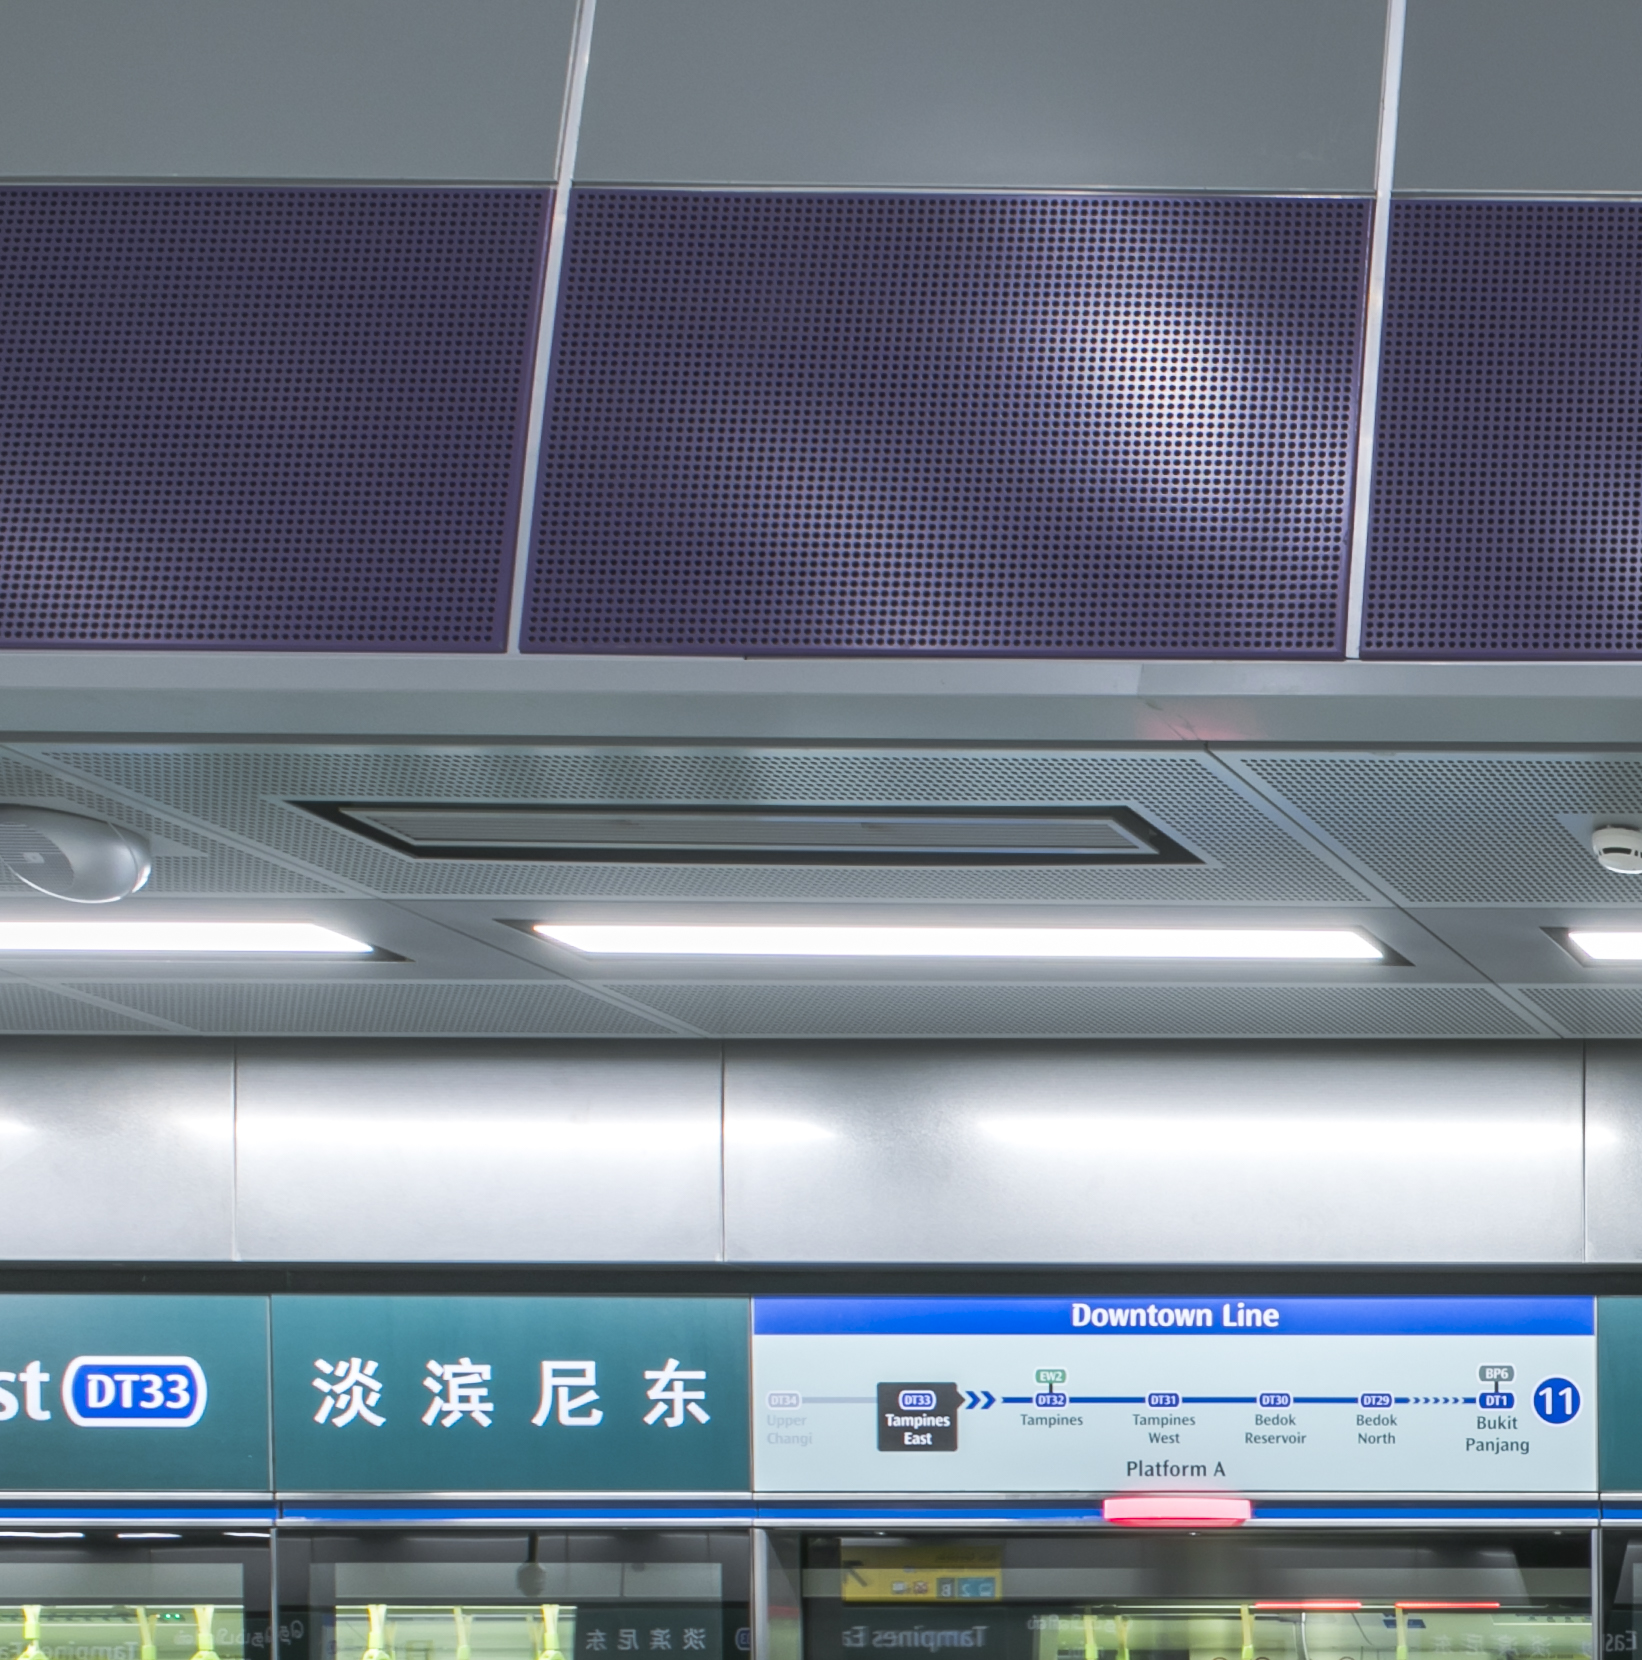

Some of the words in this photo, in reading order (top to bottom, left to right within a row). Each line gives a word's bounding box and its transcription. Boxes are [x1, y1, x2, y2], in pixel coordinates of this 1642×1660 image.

[1071, 1302, 1213, 1327] Downtown
[1222, 1301, 1280, 1328] Line
[1039, 1371, 1063, 1382] EW2
[1485, 1367, 1509, 1380] BP6
[86, 1373, 192, 1410] DT33
[312, 1356, 711, 1428] 淡滨尼东
[904, 1394, 932, 1407] DT33
[1038, 1394, 1065, 1406] DT32
[1150, 1394, 1176, 1405] DT31
[1262, 1395, 1289, 1406] DT30
[1363, 1395, 1390, 1406] DT29
[1485, 1394, 1507, 1407] DT1
[1538, 1386, 1574, 1415] 11
[766, 1414, 807, 1429] Upper
[884, 1413, 951, 1430] Tampines
[1020, 1413, 1084, 1429] Tampines
[1133, 1413, 1196, 1429] Tampines
[1255, 1413, 1296, 1426] Bedok
[1356, 1414, 1398, 1426] Bedok
[1477, 1415, 1518, 1430] Bukit
[766, 1432, 813, 1448] Changi
[903, 1431, 933, 1445] East
[1148, 1432, 1180, 1444] West
[1245, 1432, 1307, 1444] Reservoir
[1358, 1432, 1396, 1444] North
[1466, 1437, 1530, 1455] Panjang
[1127, 1459, 1207, 1477] Platform
[1213, 1461, 1226, 1477] A
